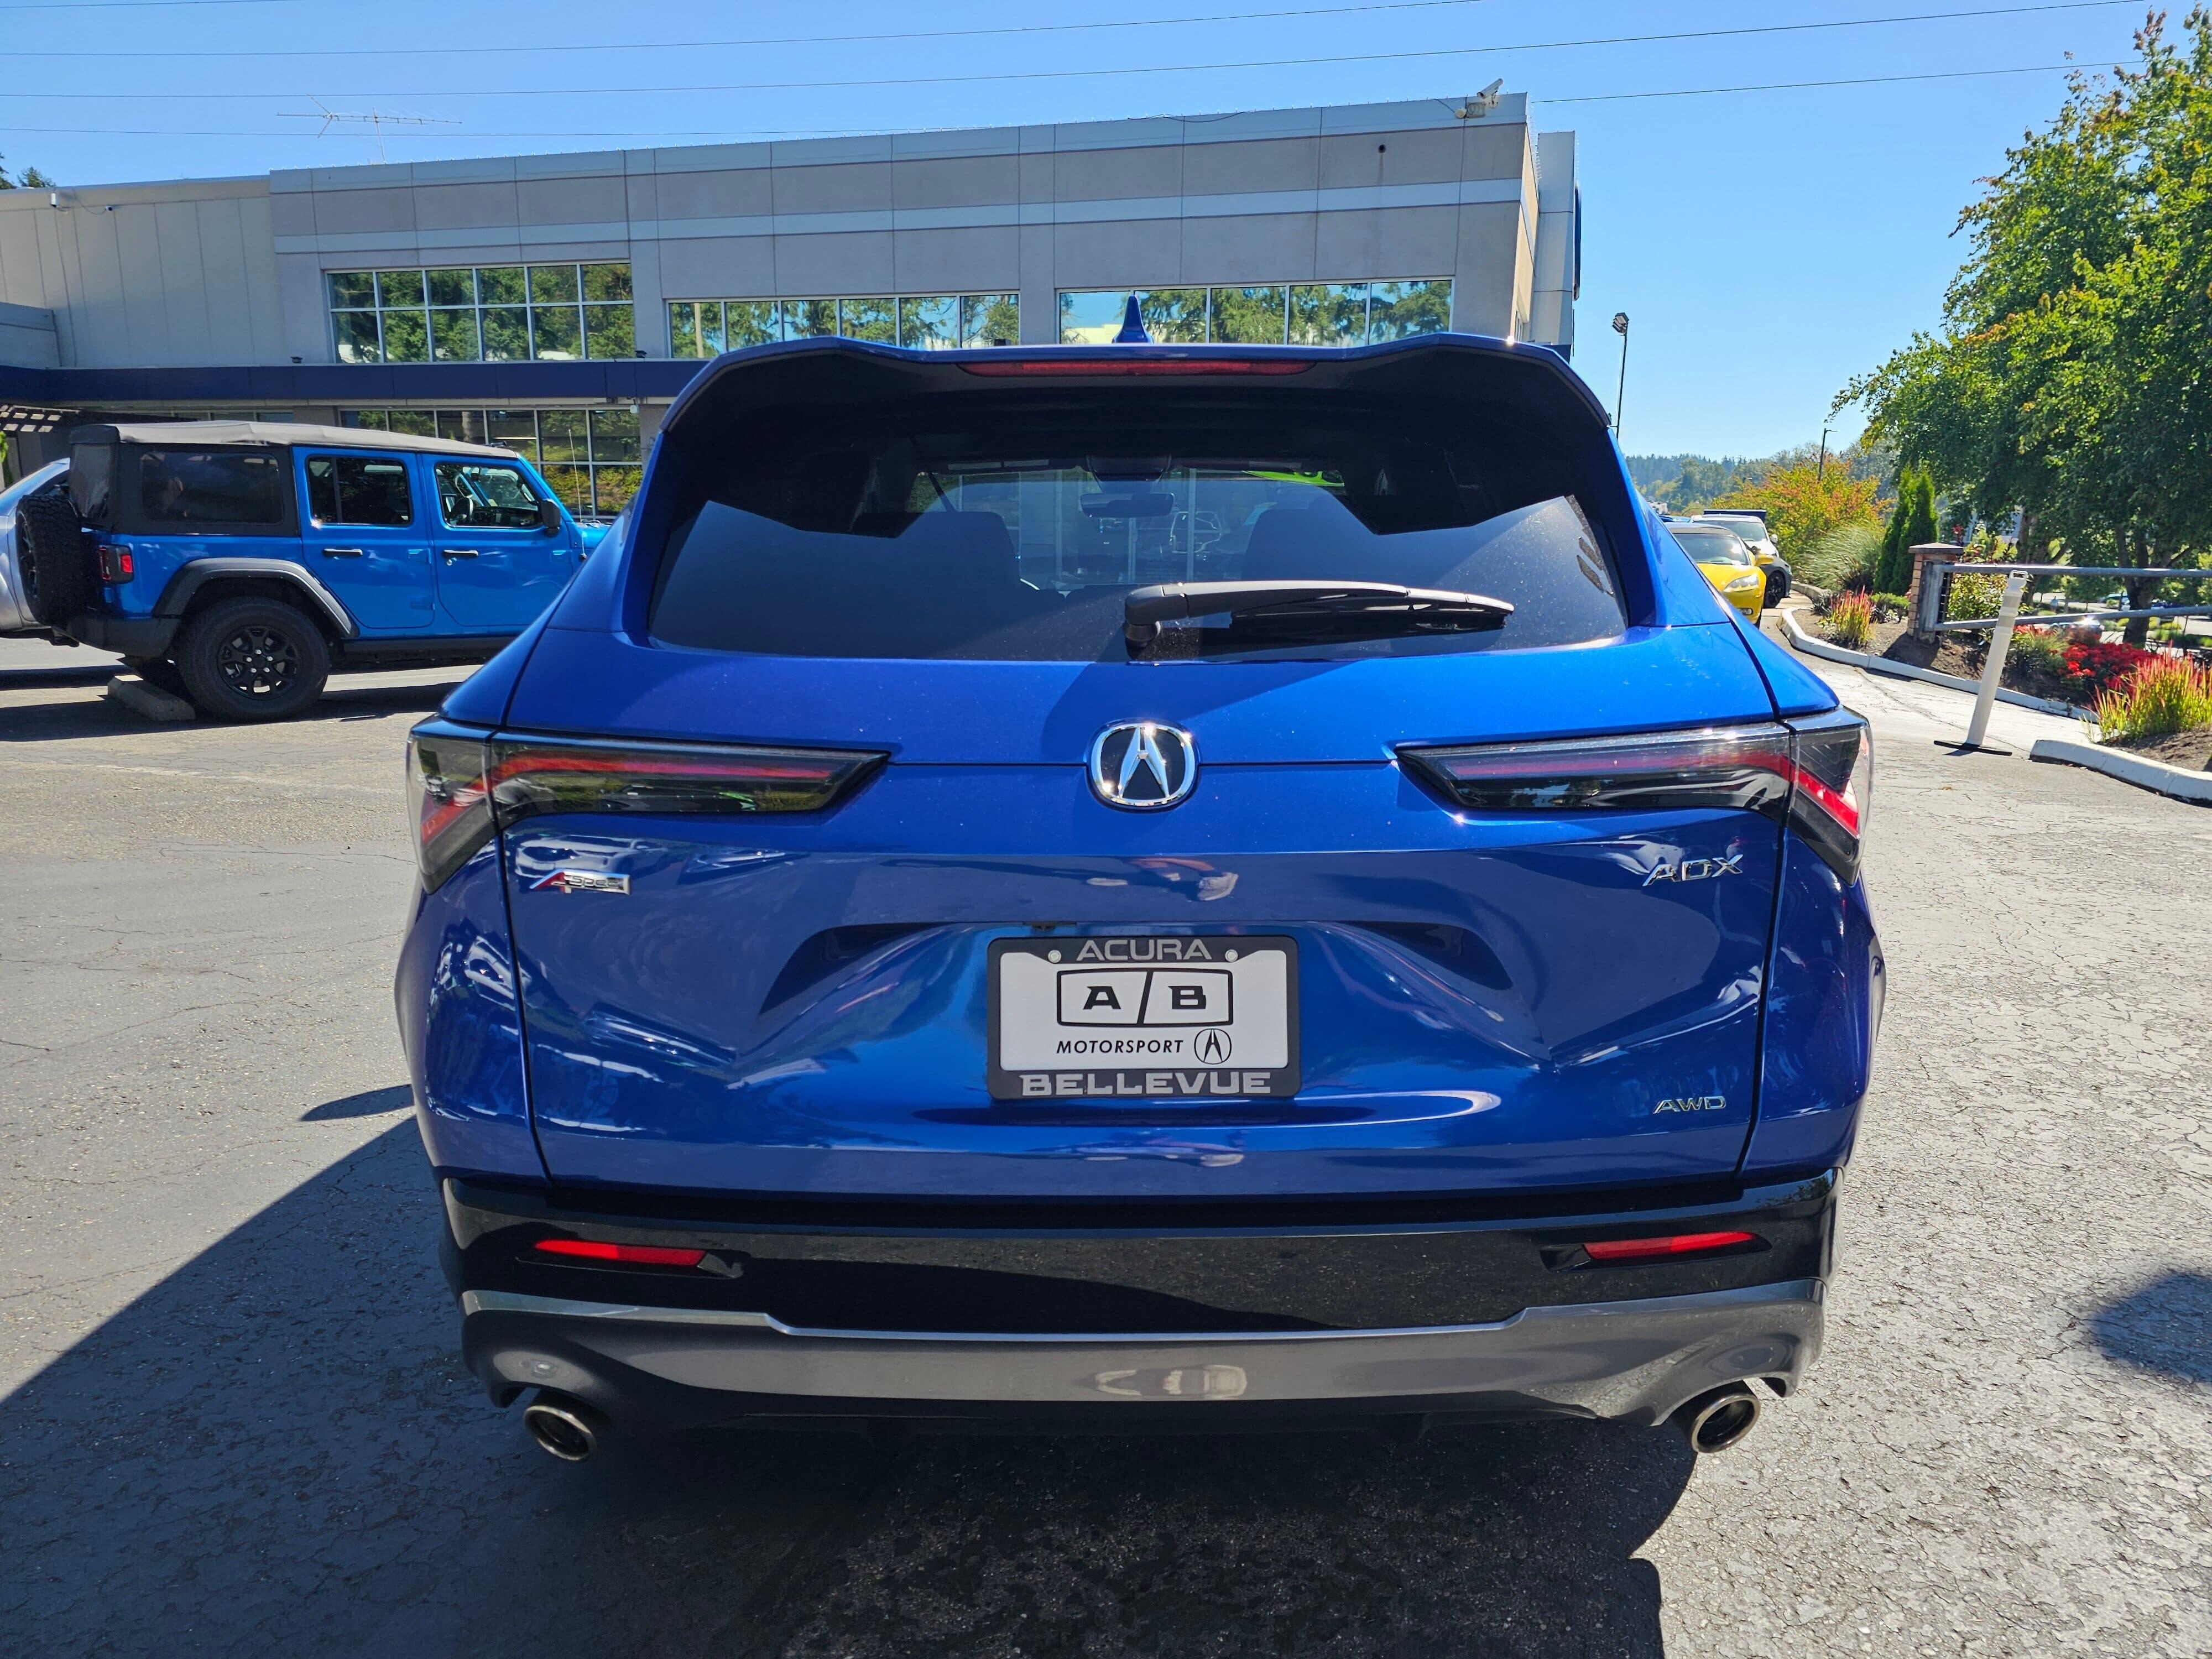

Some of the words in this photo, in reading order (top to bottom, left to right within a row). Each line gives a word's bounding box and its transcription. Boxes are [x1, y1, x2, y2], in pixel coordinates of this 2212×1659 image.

[1642, 854, 1744, 886] ADX
[1076, 938, 1212, 961] ACURA
[1056, 1039, 1184, 1054] MOTORSPORT
[1019, 1071, 1271, 1096] BELLEVUE
[1652, 1095, 1726, 1114] AWD
